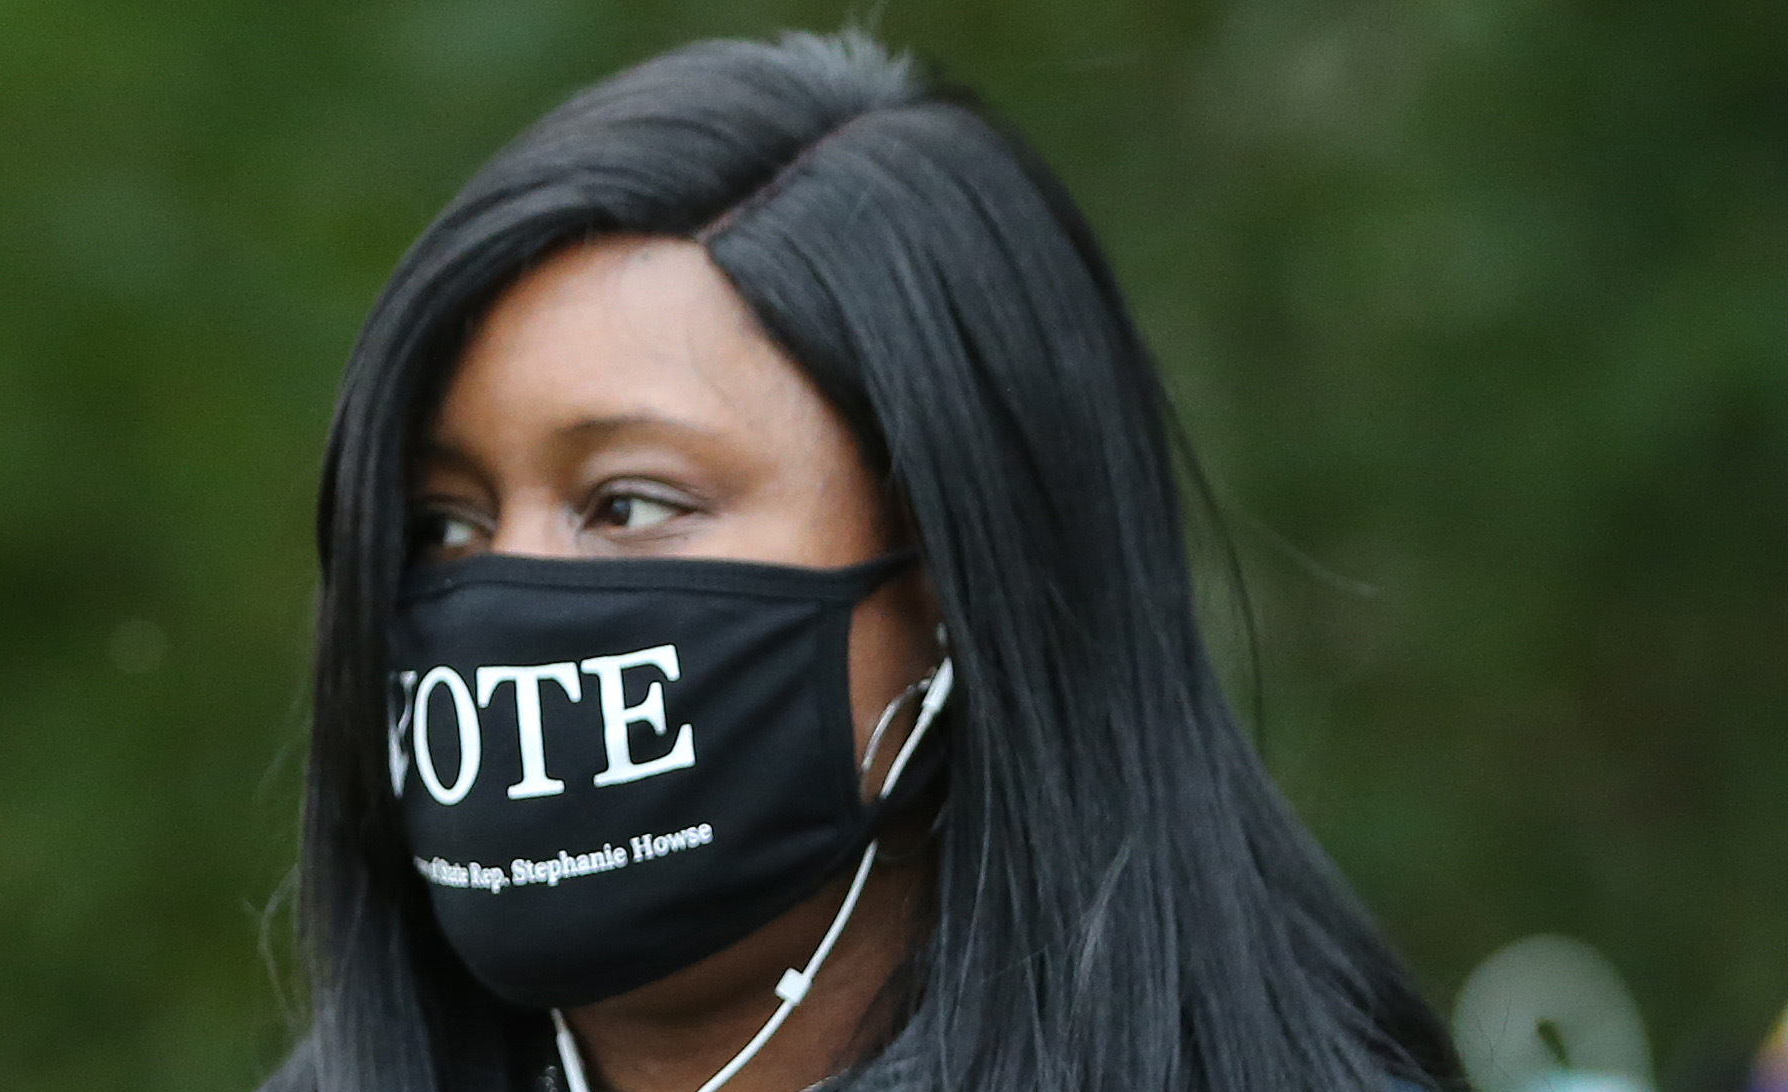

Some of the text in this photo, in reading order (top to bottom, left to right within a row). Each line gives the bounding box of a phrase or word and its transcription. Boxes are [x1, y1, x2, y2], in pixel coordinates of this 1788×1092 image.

[387, 644, 696, 806] VOTE
[468, 861, 511, 894] Rep.
[511, 843, 628, 887] Stephanie
[630, 823, 714, 863] Howse
